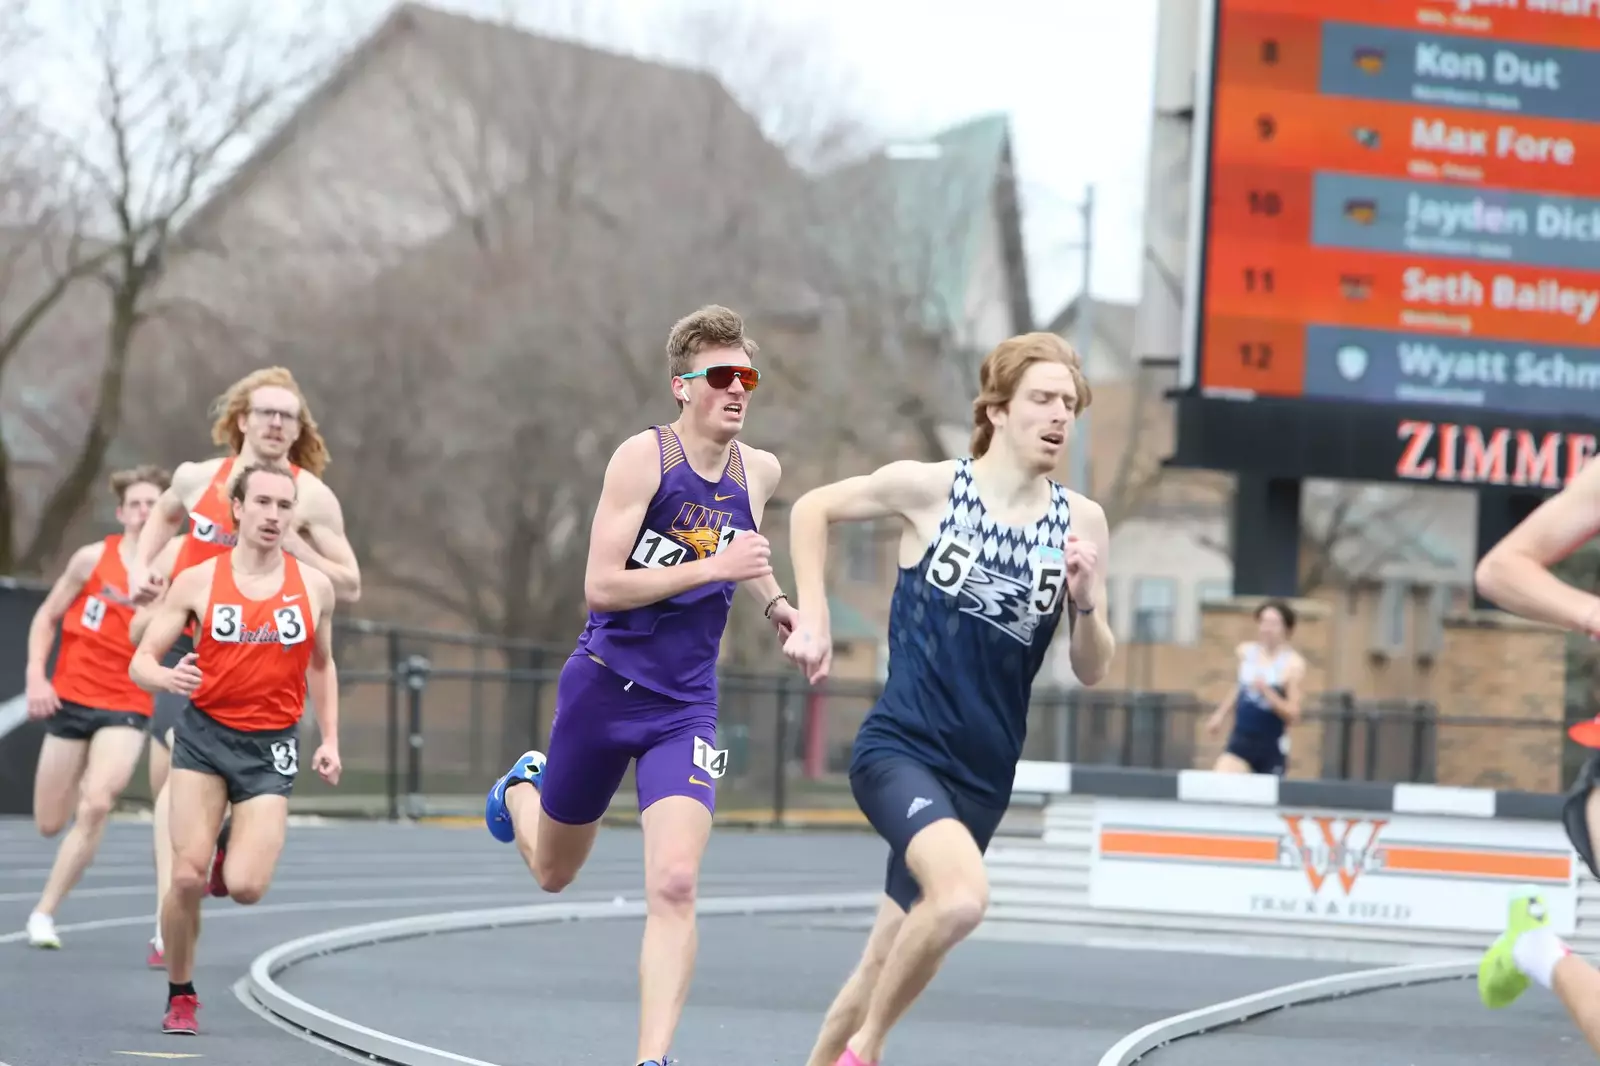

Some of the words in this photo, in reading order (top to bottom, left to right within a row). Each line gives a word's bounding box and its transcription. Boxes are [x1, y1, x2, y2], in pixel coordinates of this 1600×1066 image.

[1414, 42, 1486, 83] Kon
[1493, 50, 1561, 90] Dut
[1411, 118, 1488, 157] Max
[1496, 126, 1575, 165] Fore
[1405, 191, 1527, 237] Jayden
[1243, 268, 1275, 293] 11
[1402, 266, 1483, 306] Seth
[1491, 274, 1600, 324] Bailey
[1239, 342, 1273, 370] 12
[1397, 339, 1508, 388] Wyatt
[931, 541, 971, 588] 5
[1034, 567, 1062, 613] 5
[214, 606, 236, 637] 3
[277, 608, 301, 640] 3
[275, 742, 294, 771] 3
[697, 743, 727, 776] 14
